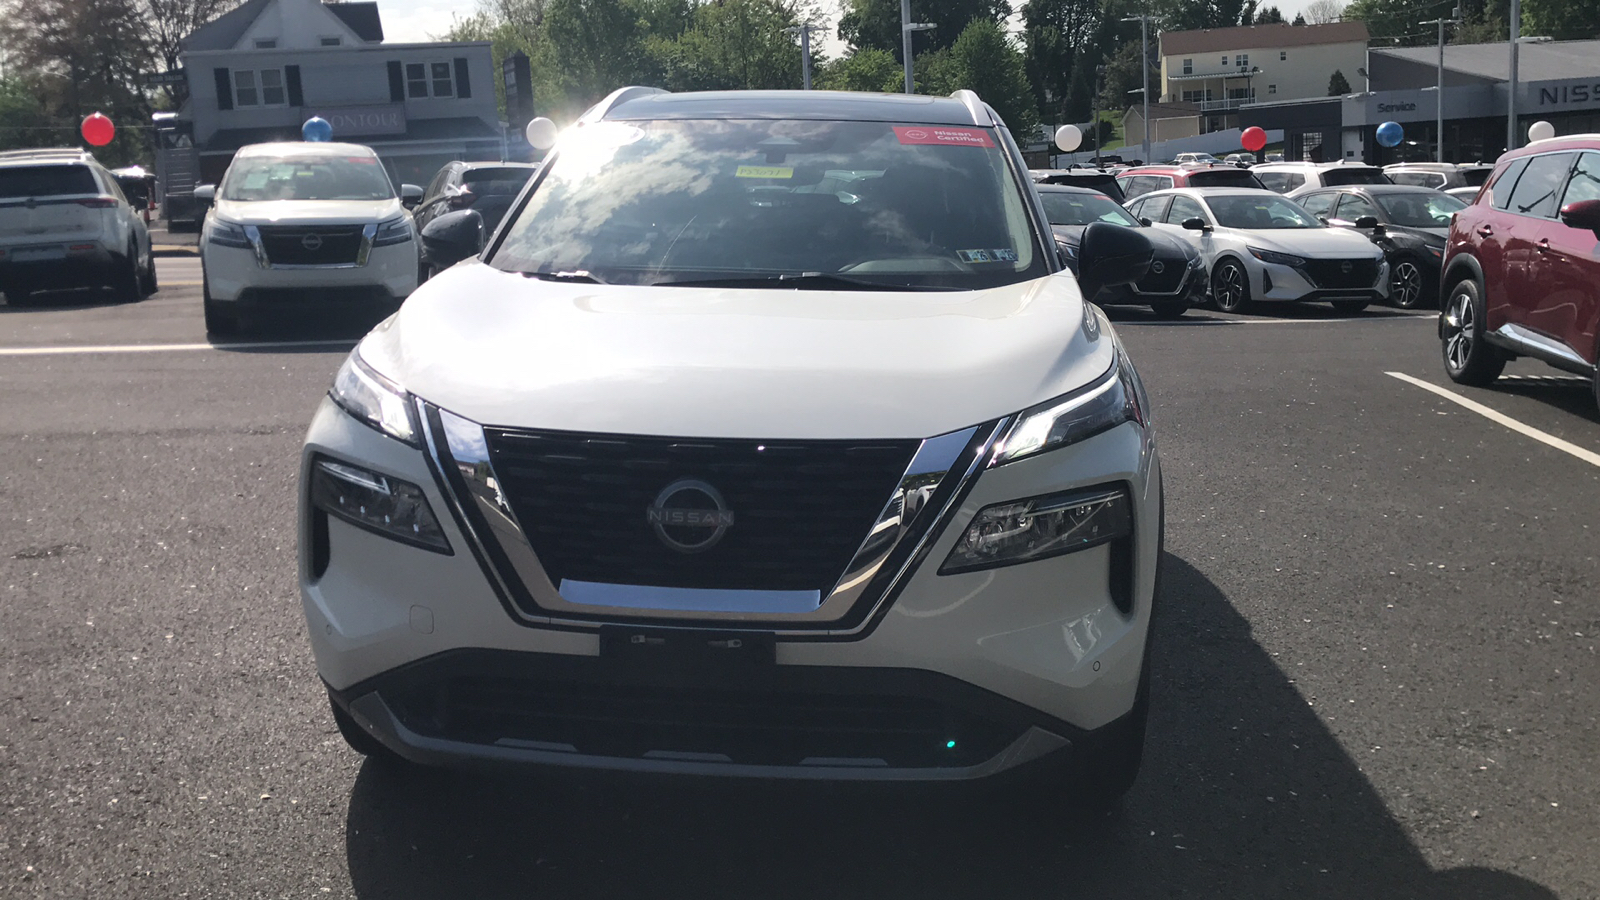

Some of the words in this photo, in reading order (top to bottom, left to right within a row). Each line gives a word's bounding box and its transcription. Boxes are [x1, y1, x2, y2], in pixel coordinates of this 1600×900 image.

[1377, 101, 1416, 113] Service
[330, 112, 399, 129] ONTOUR
[937, 135, 984, 143] Certified
[649, 510, 731, 523] NISSAN
